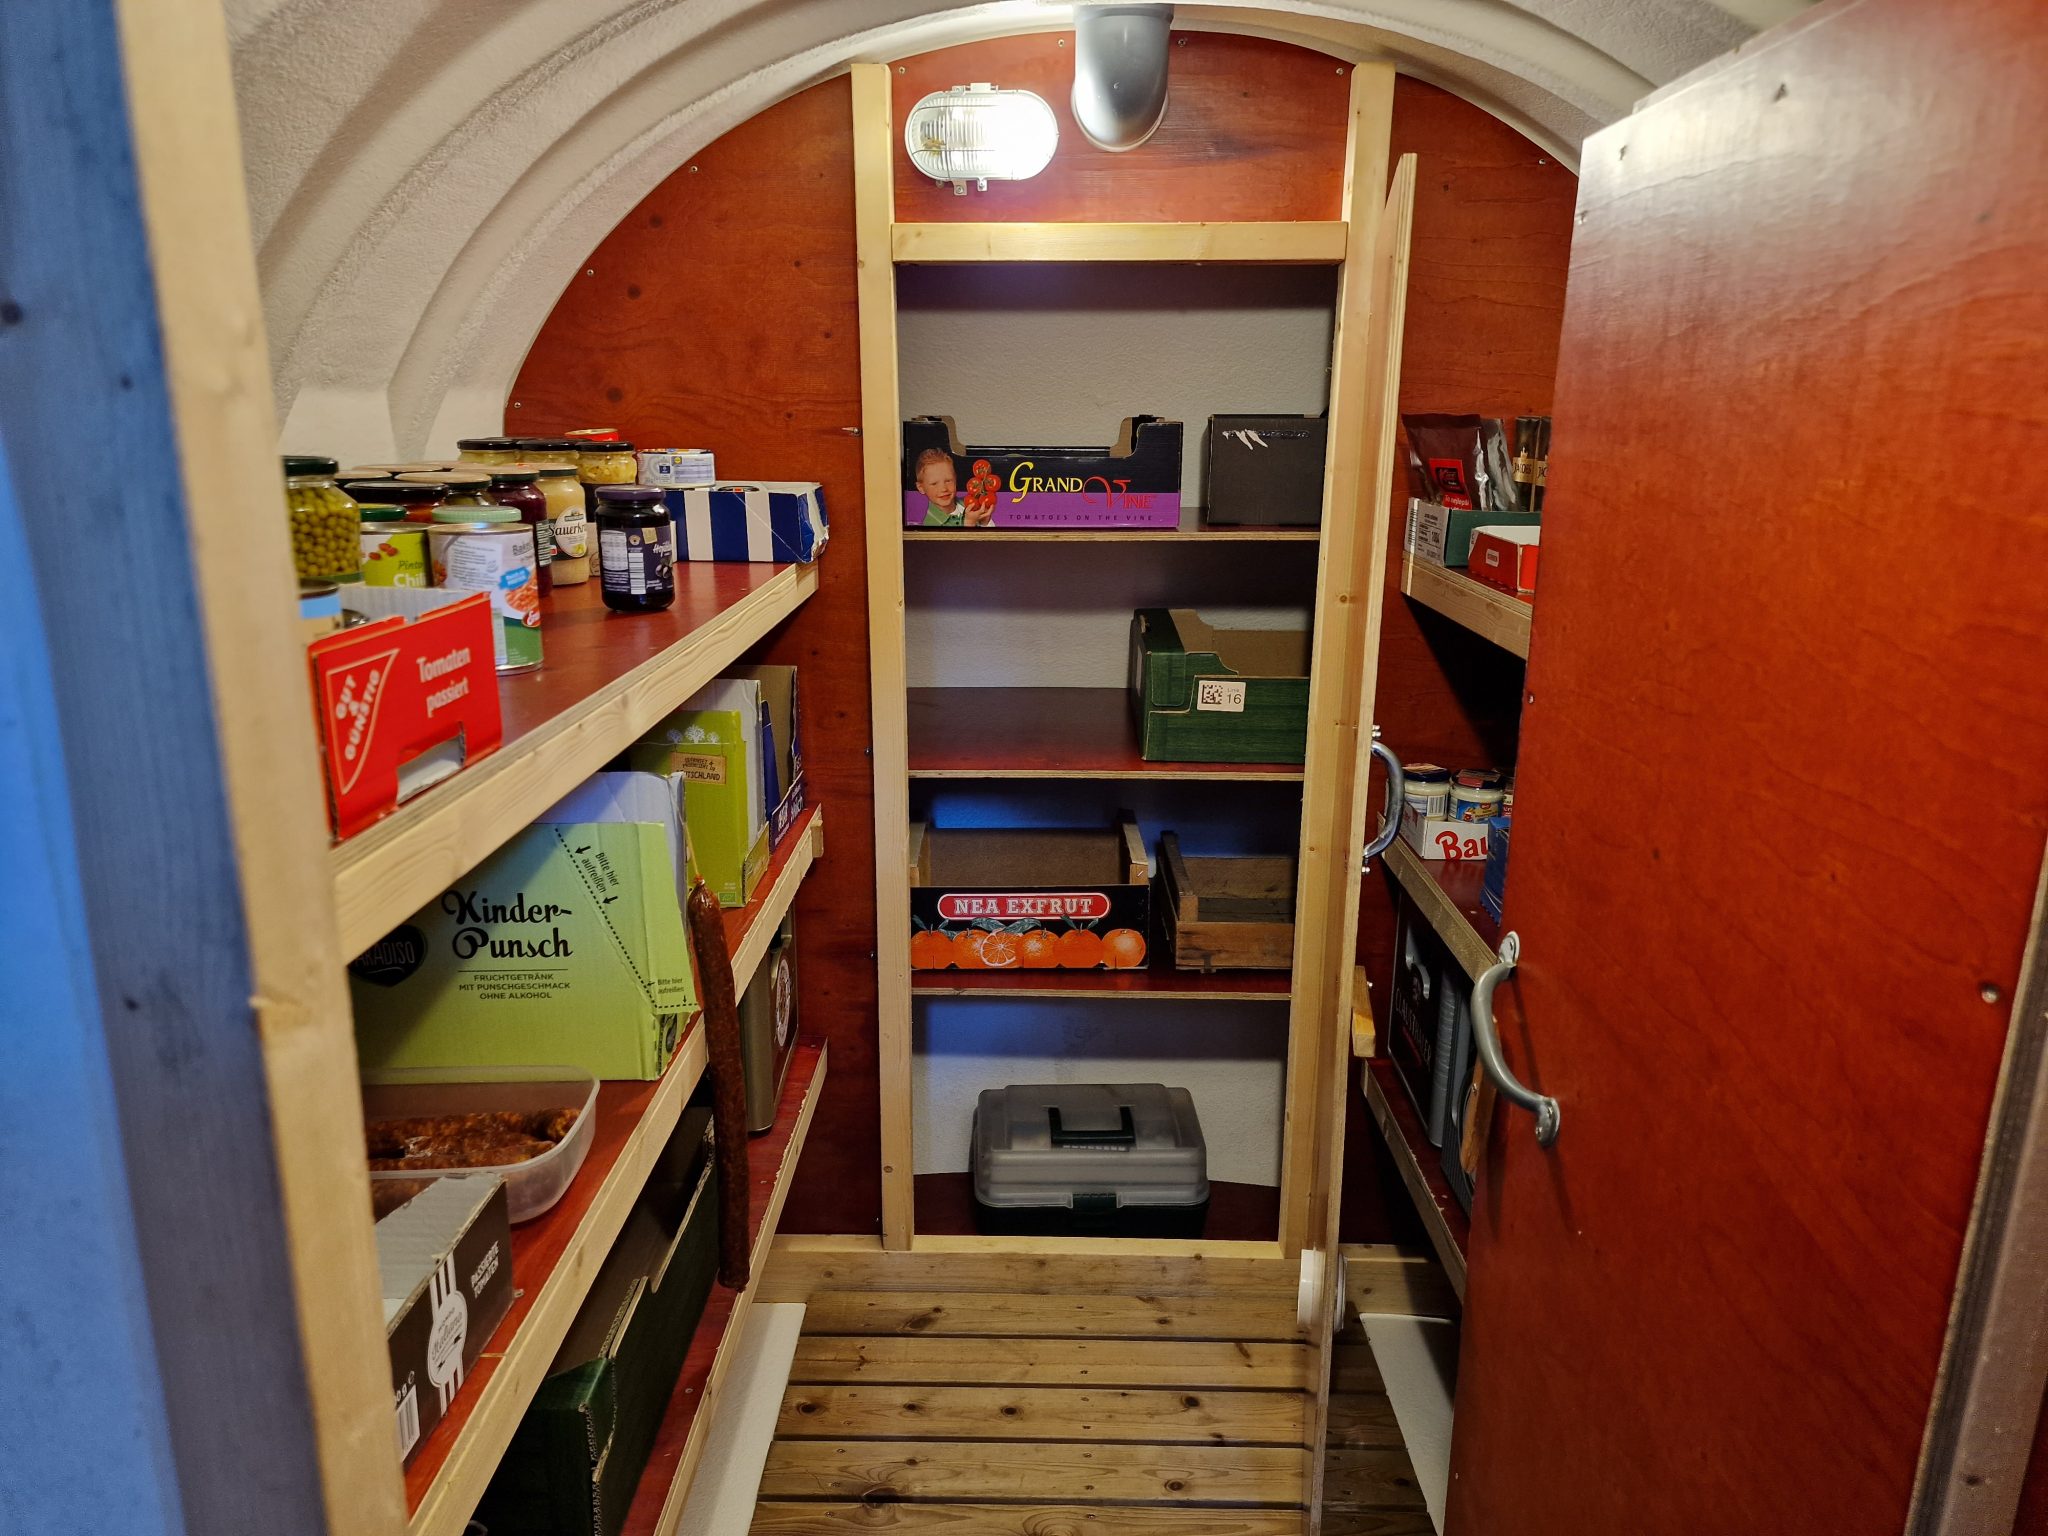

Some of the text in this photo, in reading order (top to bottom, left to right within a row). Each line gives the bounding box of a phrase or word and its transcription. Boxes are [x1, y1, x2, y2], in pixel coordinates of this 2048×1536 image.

[1009, 461, 1154, 510] GRAND VINE
[416, 647, 471, 683] Tomaten
[336, 674, 356, 719] GUT
[426, 676, 469, 718] passiert
[1227, 693, 1242, 705] 16
[581, 858, 606, 893] aufreißen
[595, 852, 619, 886] Bitte hier
[441, 890, 572, 925] Kinder-
[954, 897, 1093, 914] NEA EXFRUT
[452, 927, 573, 960] Punsch
[474, 973, 554, 982] FRUCHTGETRÄNK
[477, 982, 570, 991] PUNSCHGESCHMACK
[509, 991, 552, 999] ALKOHOL
